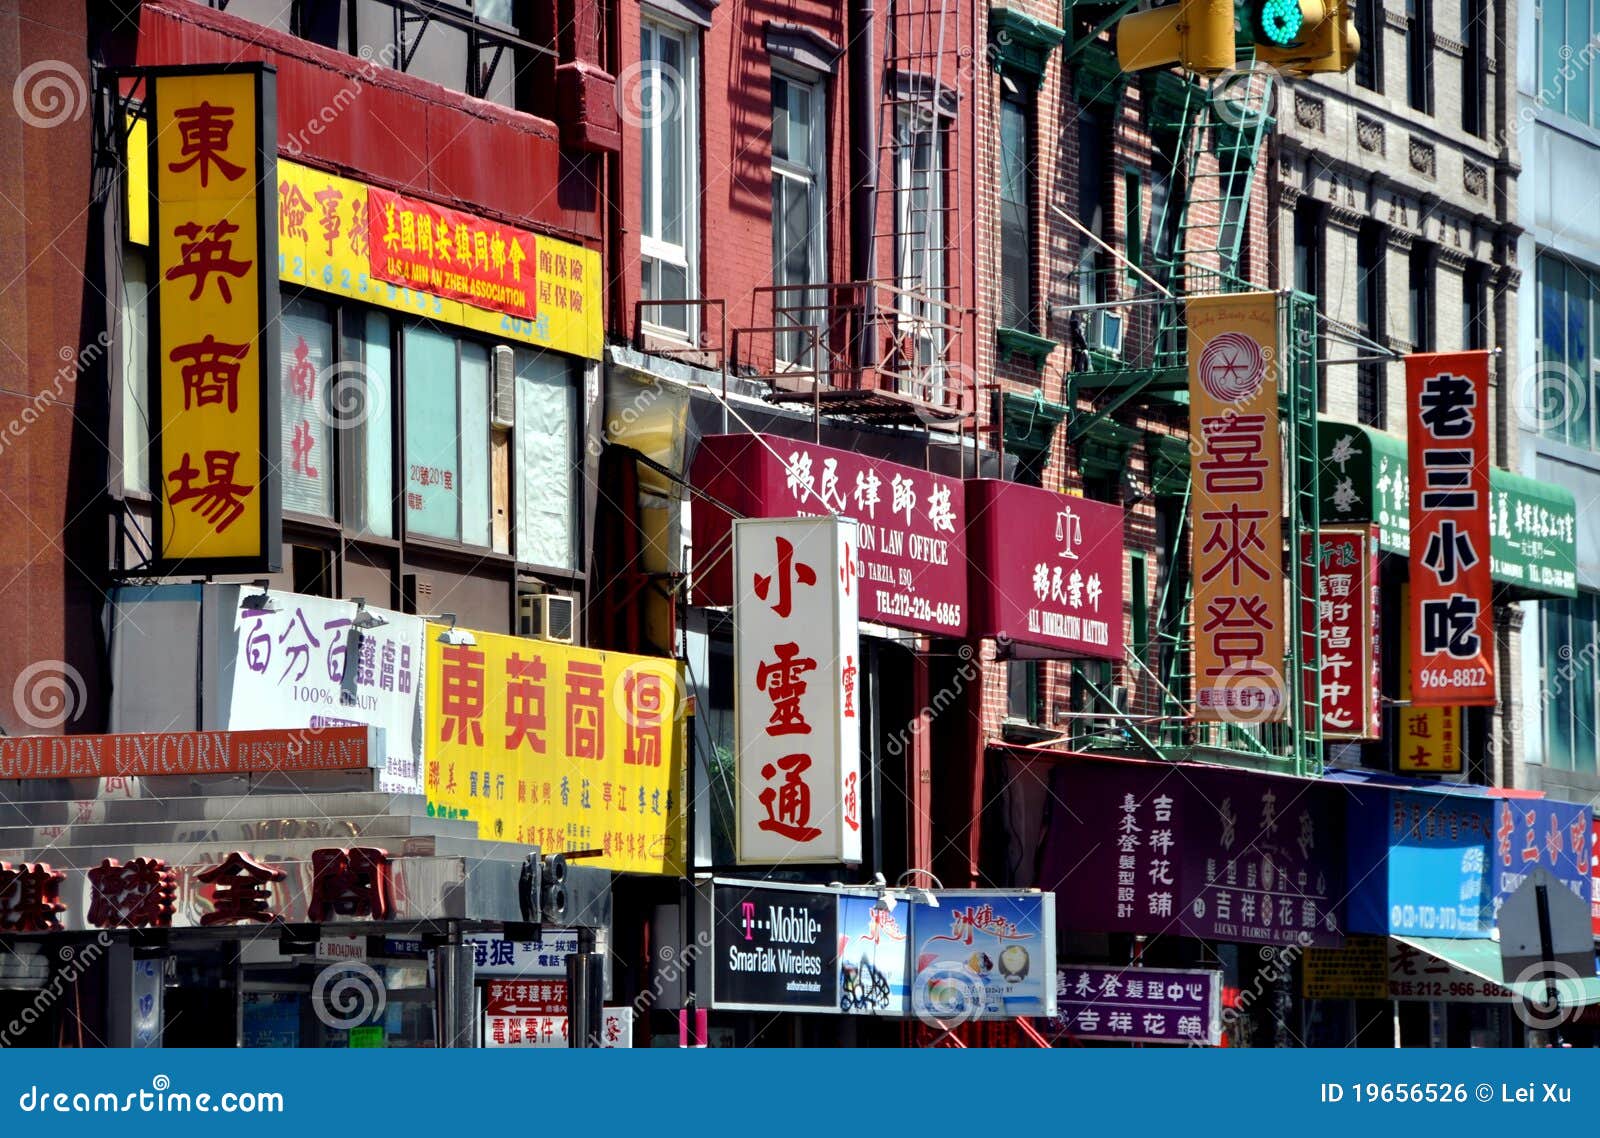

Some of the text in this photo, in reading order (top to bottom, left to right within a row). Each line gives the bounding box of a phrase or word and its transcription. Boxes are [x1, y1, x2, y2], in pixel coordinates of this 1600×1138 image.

[411, 263, 429, 285] MIN
[431, 269, 443, 287] AN
[444, 272, 468, 293] ZHEN
[470, 279, 526, 308] ASSOCIATION
[166, 101, 253, 534] 東英商場
[785, 450, 958, 534] 移民律師樓
[1420, 374, 1482, 661] 老三小吃
[880, 527, 905, 557] LAW
[908, 533, 949, 566] OFFICE
[1199, 412, 1277, 677] 喜來登
[1032, 562, 1103, 614] 移民案件
[1028, 607, 1041, 634] ALL
[1082, 617, 1109, 647] MATTERS
[292, 685, 334, 705] 100%
[752, 534, 825, 845] 小靈通
[1420, 667, 1487, 690] 966-8822
[440, 645, 663, 768] 東英商場
[0, 733, 367, 777] GOLDEN UNICORN RESTAURANT
[1497, 801, 1590, 876] 老三小吃
[327, 943, 363, 958] BROADWAY
[1214, 921, 1239, 936] LUCKY
[1242, 925, 1271, 940] FLORIST
[729, 945, 821, 975] SmarTalk Wireless
[492, 1018, 554, 1044] 電腦零件
